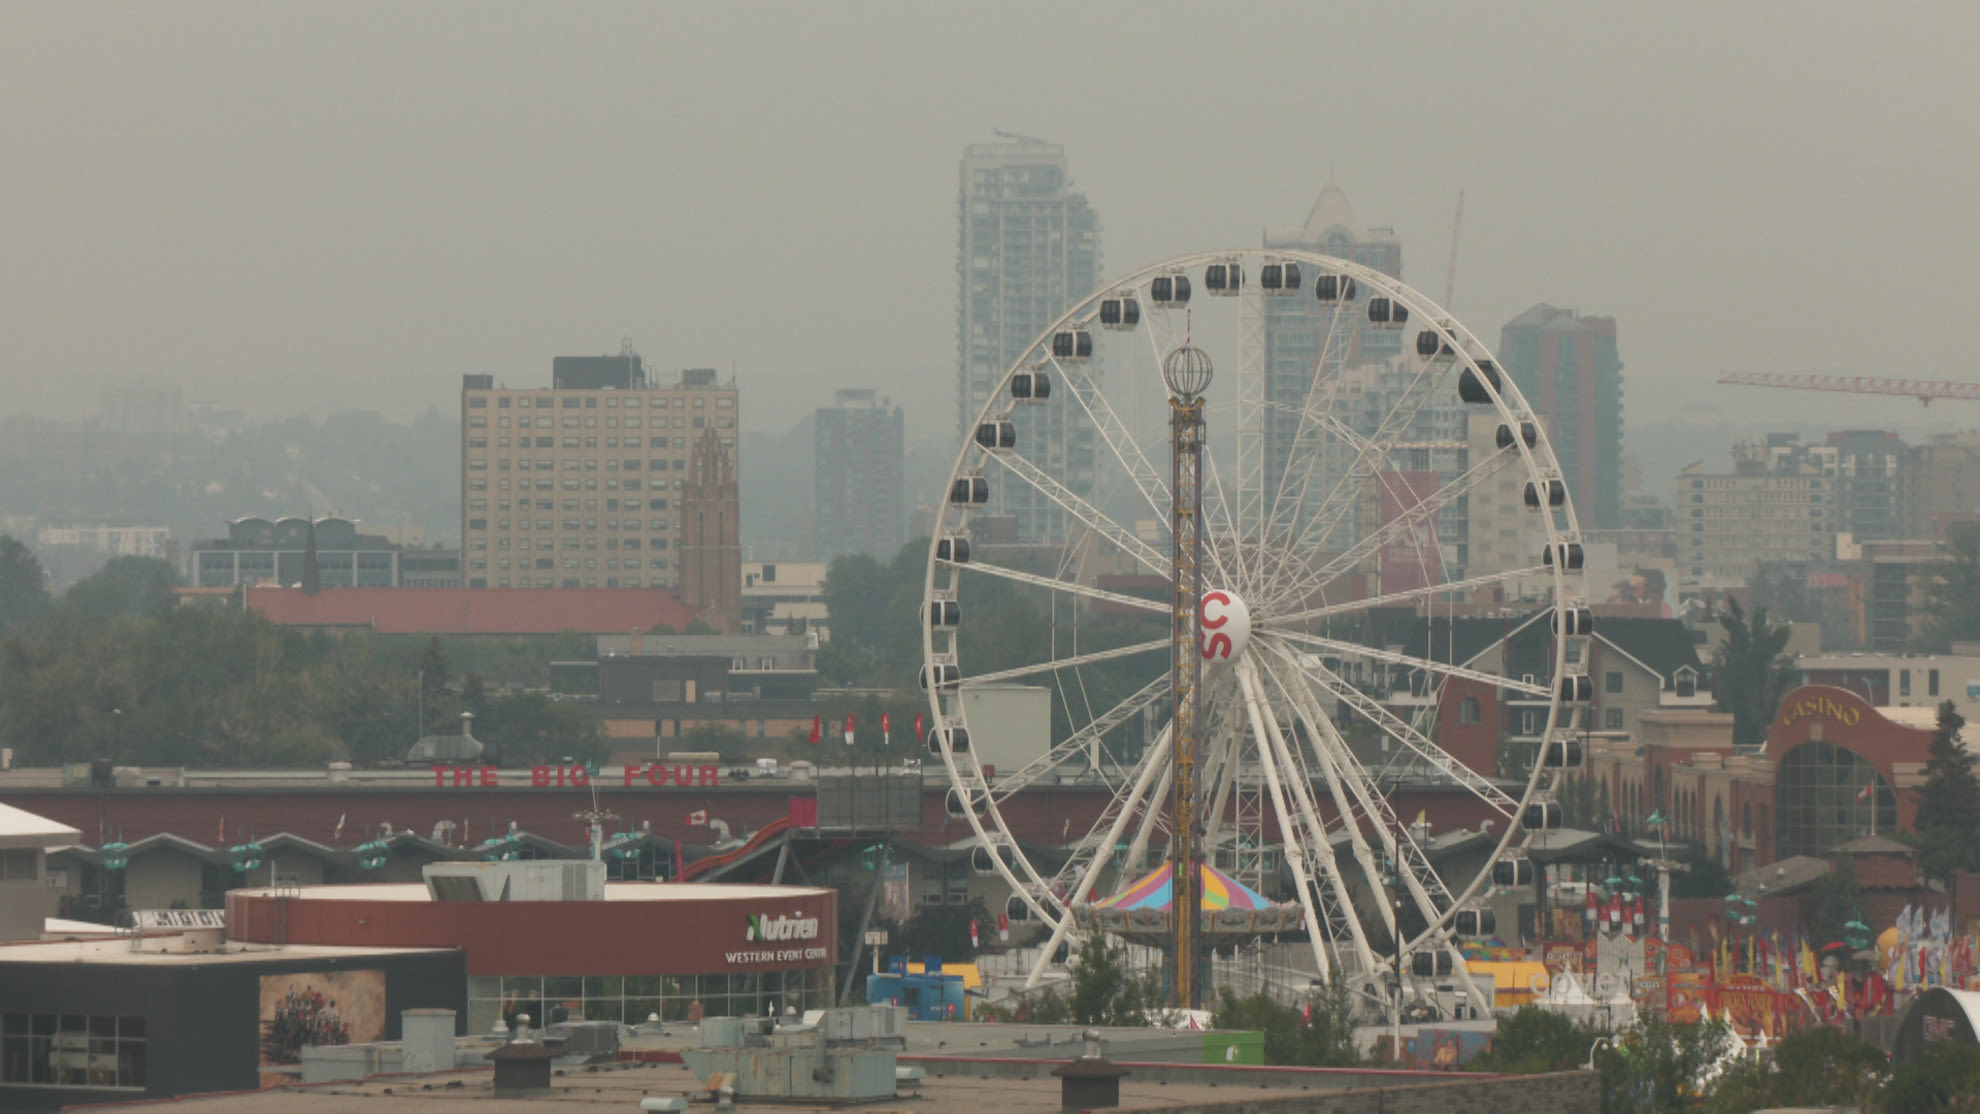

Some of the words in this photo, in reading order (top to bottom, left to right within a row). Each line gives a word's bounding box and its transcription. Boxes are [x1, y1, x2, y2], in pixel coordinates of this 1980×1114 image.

[1783, 696, 1860, 727] CASINO
[432, 765, 499, 788] THE
[531, 765, 592, 788] BIG
[624, 765, 720, 788] FOUR
[746, 910, 819, 942] Nutrien
[725, 951, 774, 964] WESTERN
[777, 949, 803, 961] EVENT
